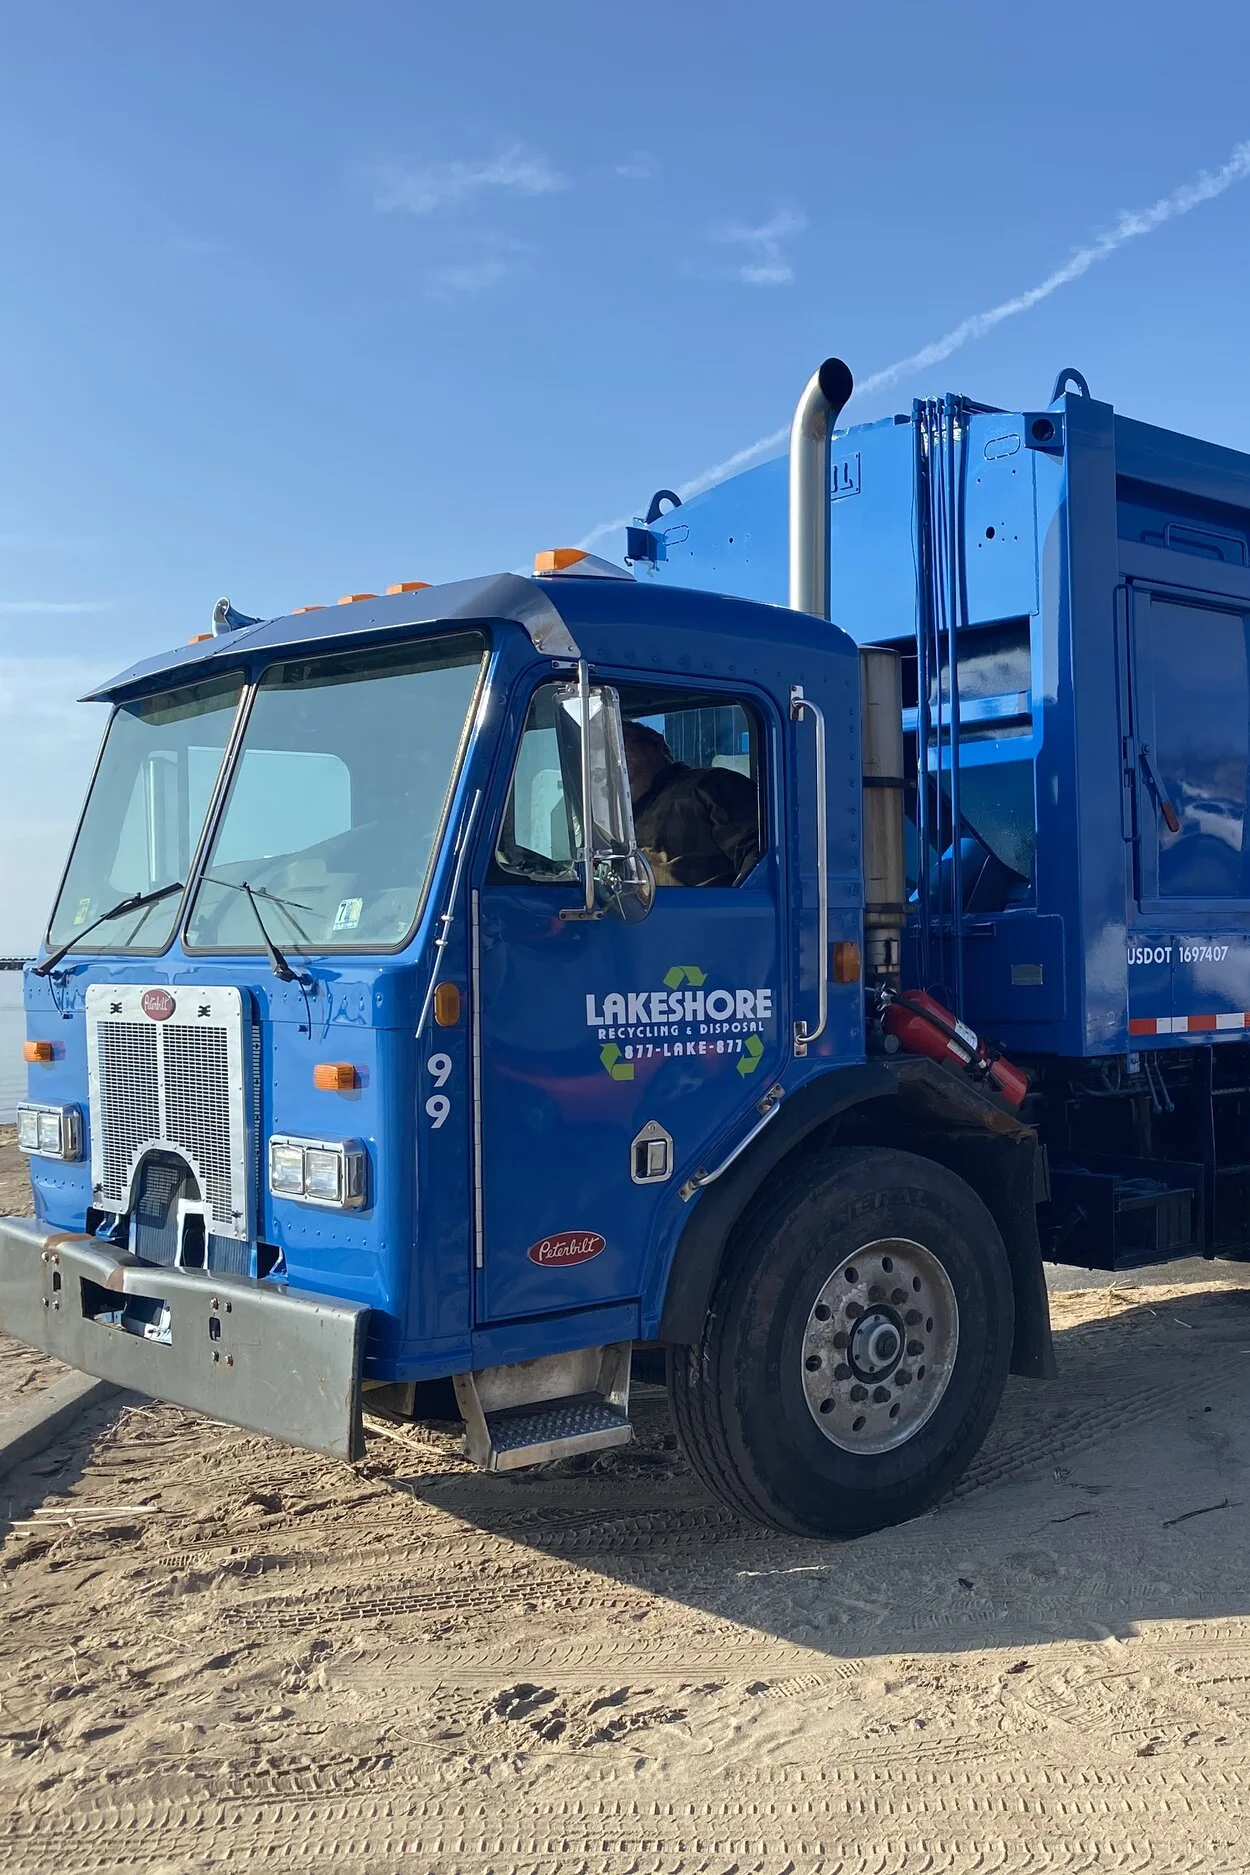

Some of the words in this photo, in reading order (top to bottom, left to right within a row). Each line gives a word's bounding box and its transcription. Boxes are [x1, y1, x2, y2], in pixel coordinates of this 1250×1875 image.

[1127, 947, 1172, 965] USDOT
[1178, 946, 1229, 963] 1697407
[585, 988, 772, 1026] LAKESHORE
[598, 1025, 679, 1040] RECYCLING
[686, 1027, 692, 1035] &
[700, 1021, 764, 1035] DISPOSAL
[624, 1039, 742, 1060] 877-LAKE-877
[538, 1237, 600, 1262] Peterbilt
